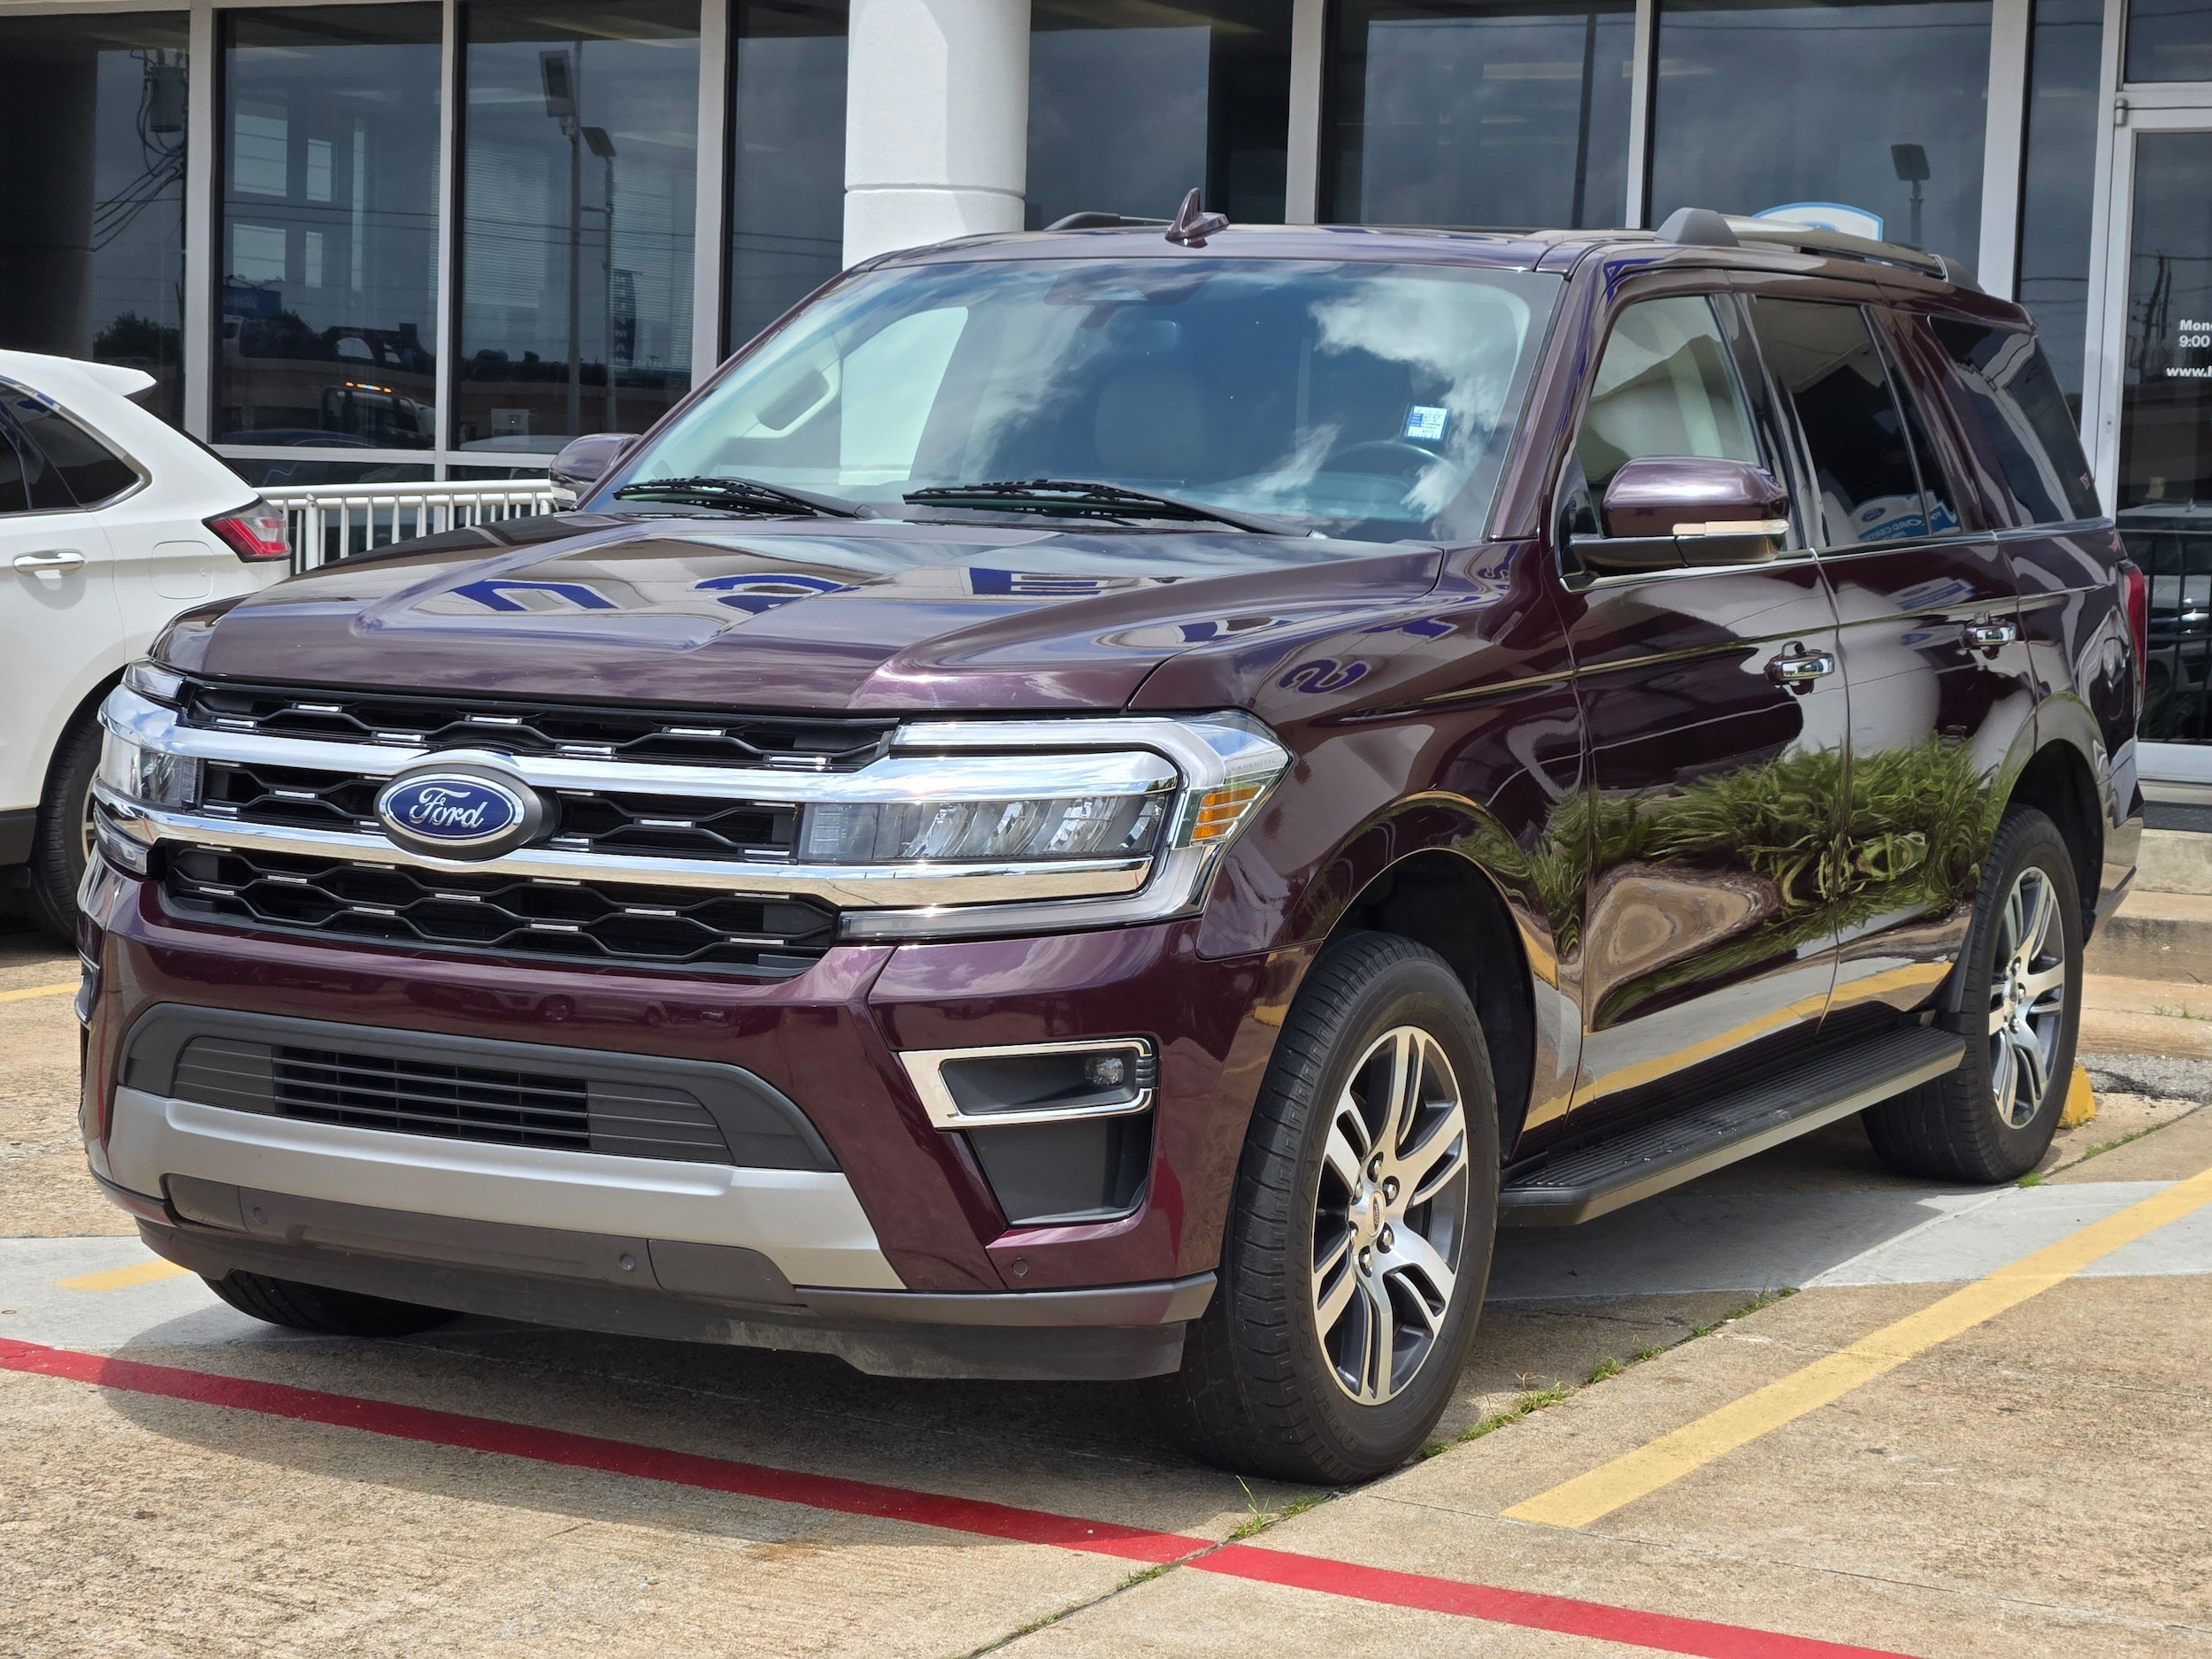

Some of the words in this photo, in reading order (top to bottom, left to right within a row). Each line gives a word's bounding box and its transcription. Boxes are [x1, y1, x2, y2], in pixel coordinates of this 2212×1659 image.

[2180, 319, 2212, 331] Mon
[2179, 335, 2210, 348] 9:00
[410, 787, 488, 828] Ford
